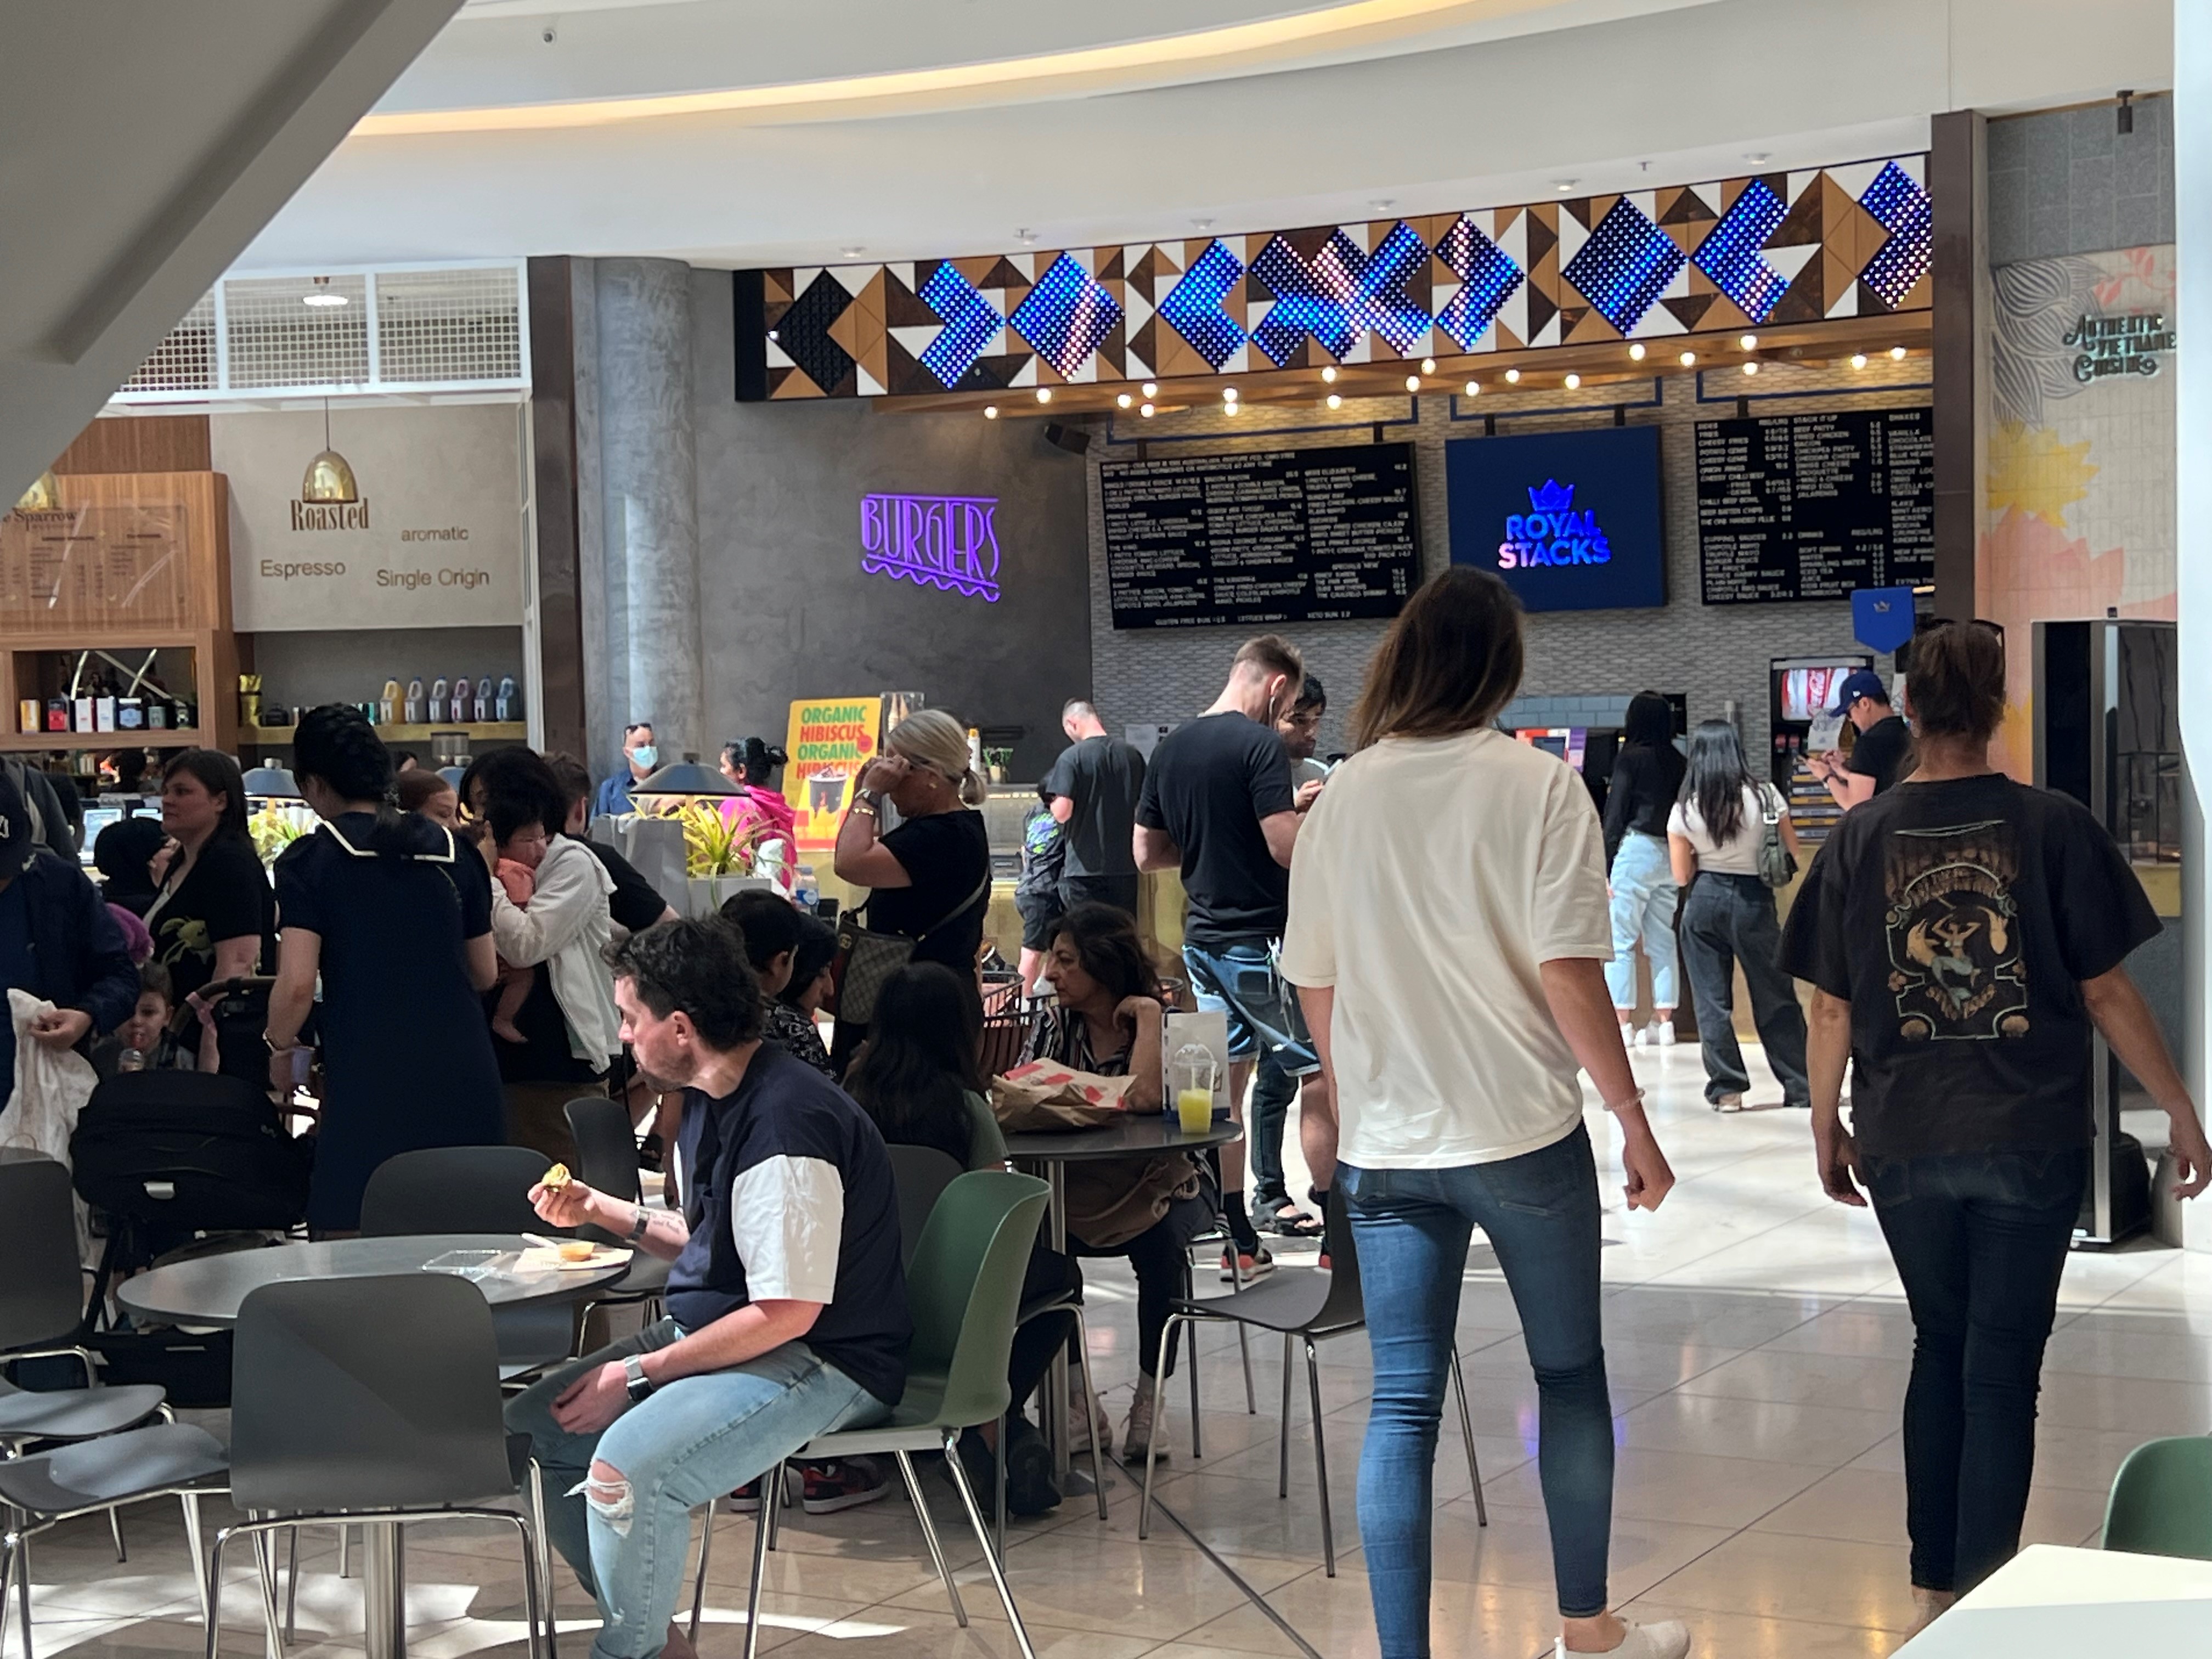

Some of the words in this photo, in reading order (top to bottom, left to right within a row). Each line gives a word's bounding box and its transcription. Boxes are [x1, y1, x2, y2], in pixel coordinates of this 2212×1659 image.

[290, 498, 370, 531] Roasted
[1506, 509, 1601, 541] ROYAL
[402, 526, 469, 541] aromatic
[861, 498, 1000, 580] BURGERS
[1498, 536, 1612, 569] STACKS
[261, 560, 346, 580] Espresso
[376, 569, 432, 590] Single
[438, 569, 489, 589] Origin
[801, 705, 867, 723] ORGANIC
[800, 724, 865, 742] HIBISCUS
